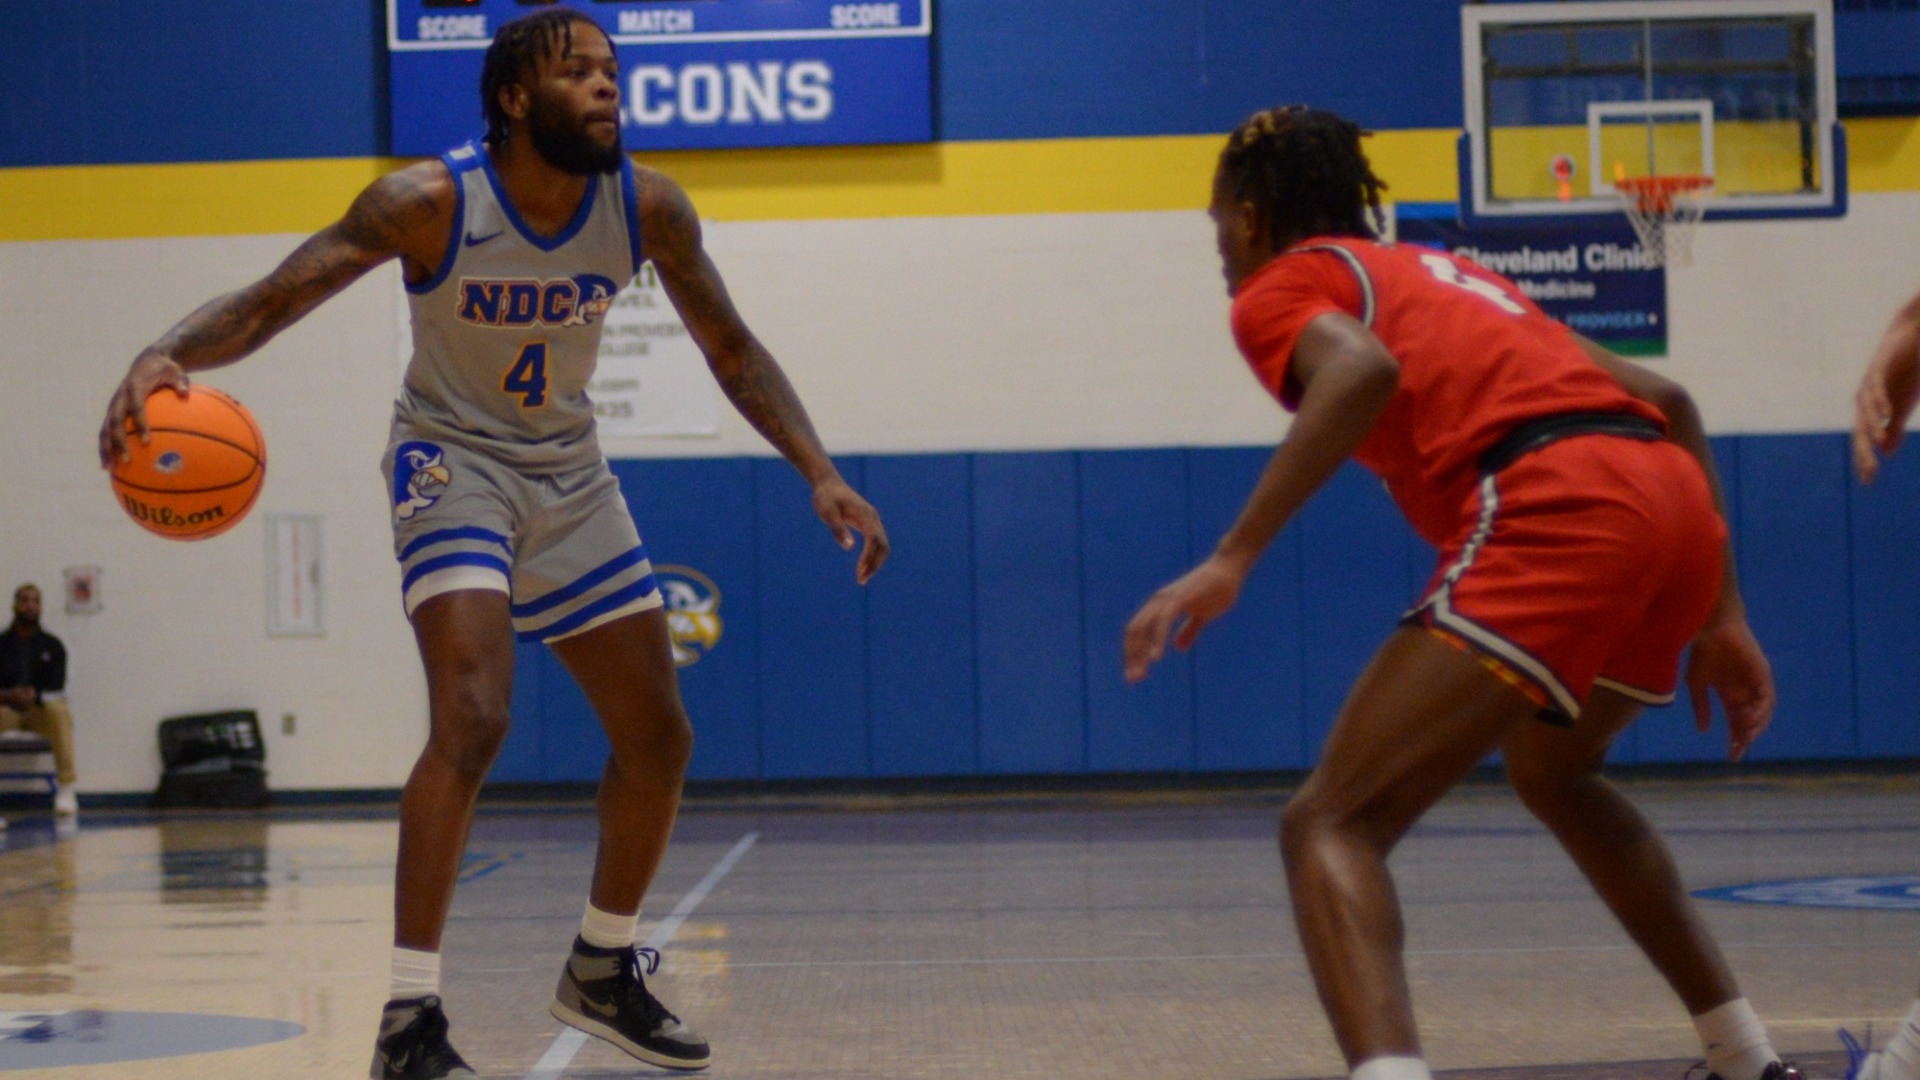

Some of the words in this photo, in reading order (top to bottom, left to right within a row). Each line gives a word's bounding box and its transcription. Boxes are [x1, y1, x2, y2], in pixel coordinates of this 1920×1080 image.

[417, 14, 487, 39] SCORE
[618, 9, 694, 34] MATCH
[830, 3, 900, 28] SCORE
[619, 61, 832, 126] CONS
[457, 277, 580, 328] NDC
[1565, 310, 1647, 330] PROVIDER
[503, 338, 549, 409] 4
[123, 494, 226, 528] Wilson
